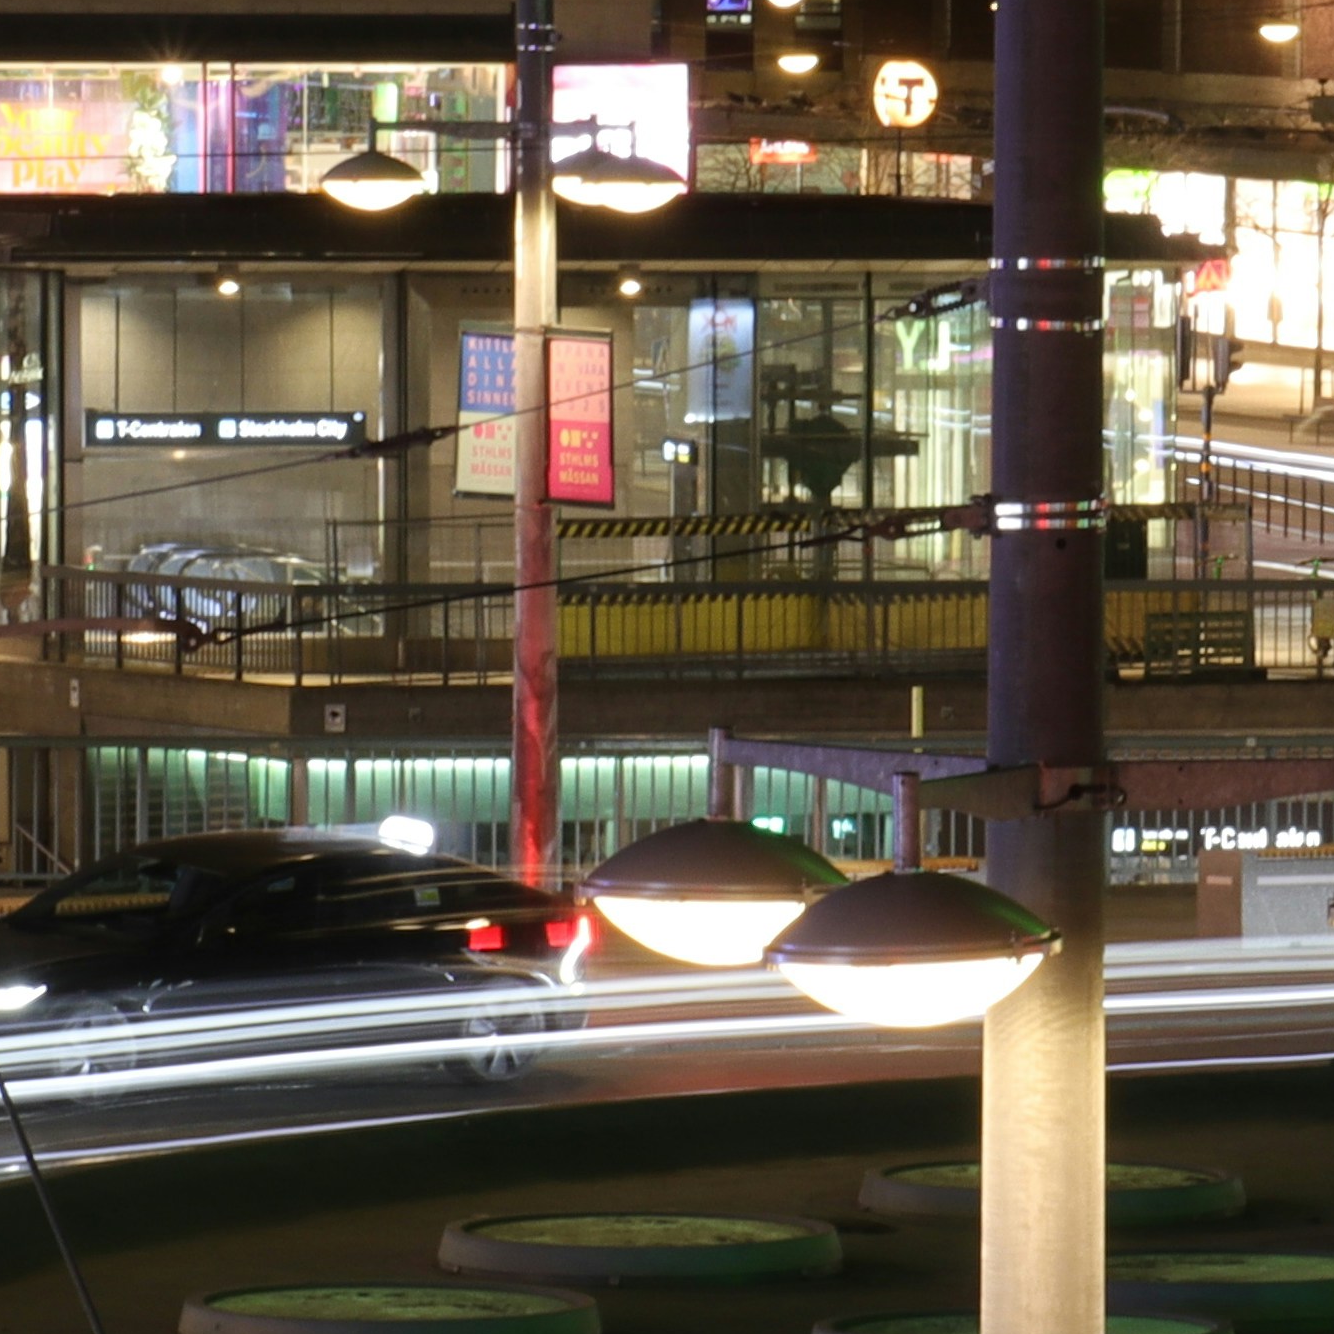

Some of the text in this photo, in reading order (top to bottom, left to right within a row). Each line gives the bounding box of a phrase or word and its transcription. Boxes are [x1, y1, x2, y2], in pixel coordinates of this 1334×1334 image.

[898, 78, 924, 116] T
[117, 419, 348, 440] T-Centralen Stockholm City
[559, 453, 599, 467] STHLMS
